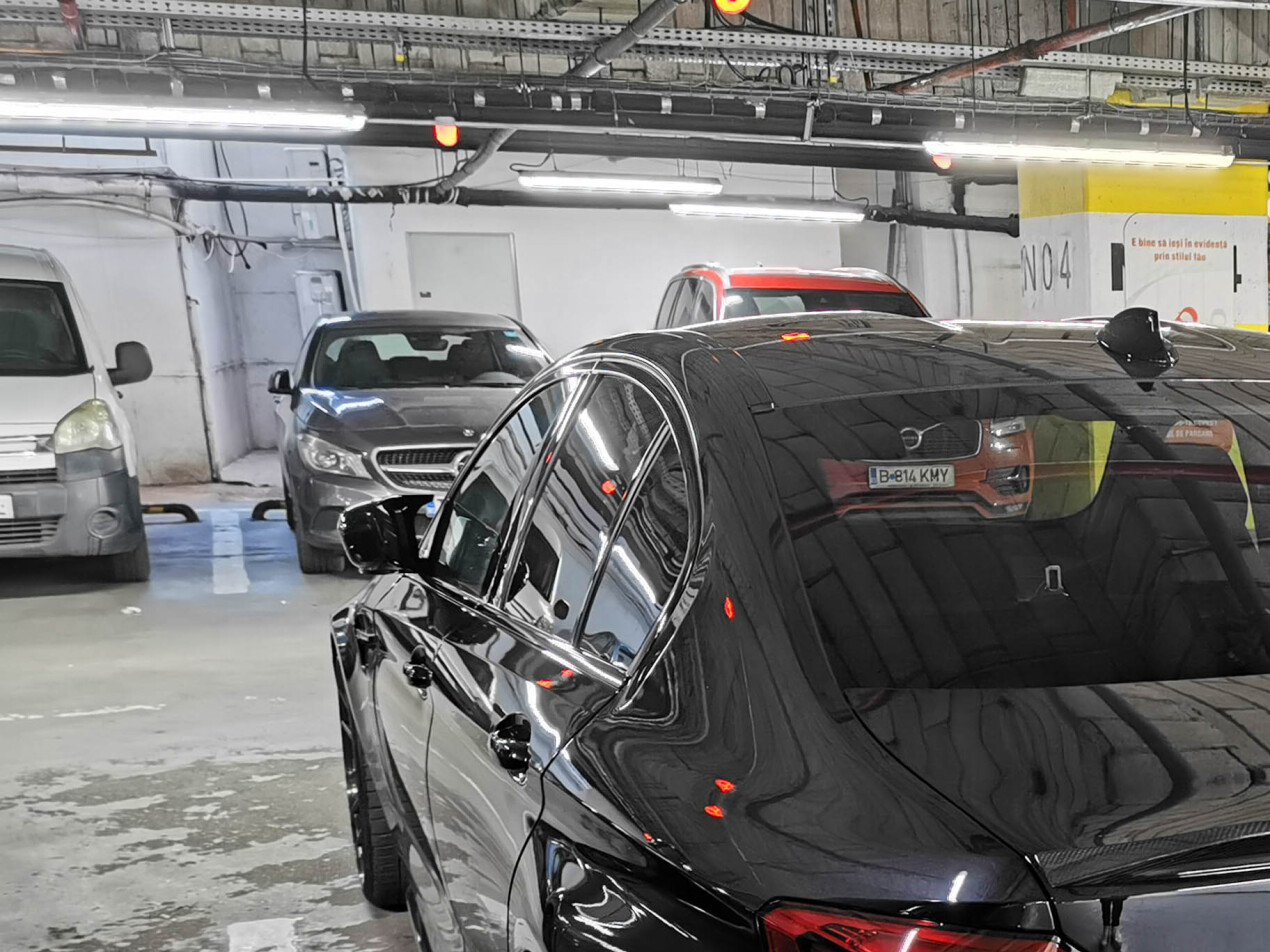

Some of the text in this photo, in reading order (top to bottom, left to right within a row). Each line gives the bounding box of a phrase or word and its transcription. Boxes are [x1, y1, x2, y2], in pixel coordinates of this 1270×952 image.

[1131, 238, 1137, 247] E
[1139, 238, 1156, 247] bine
[1154, 252, 1170, 262] prin
[880, 468, 949, 483] B 814 KMY
